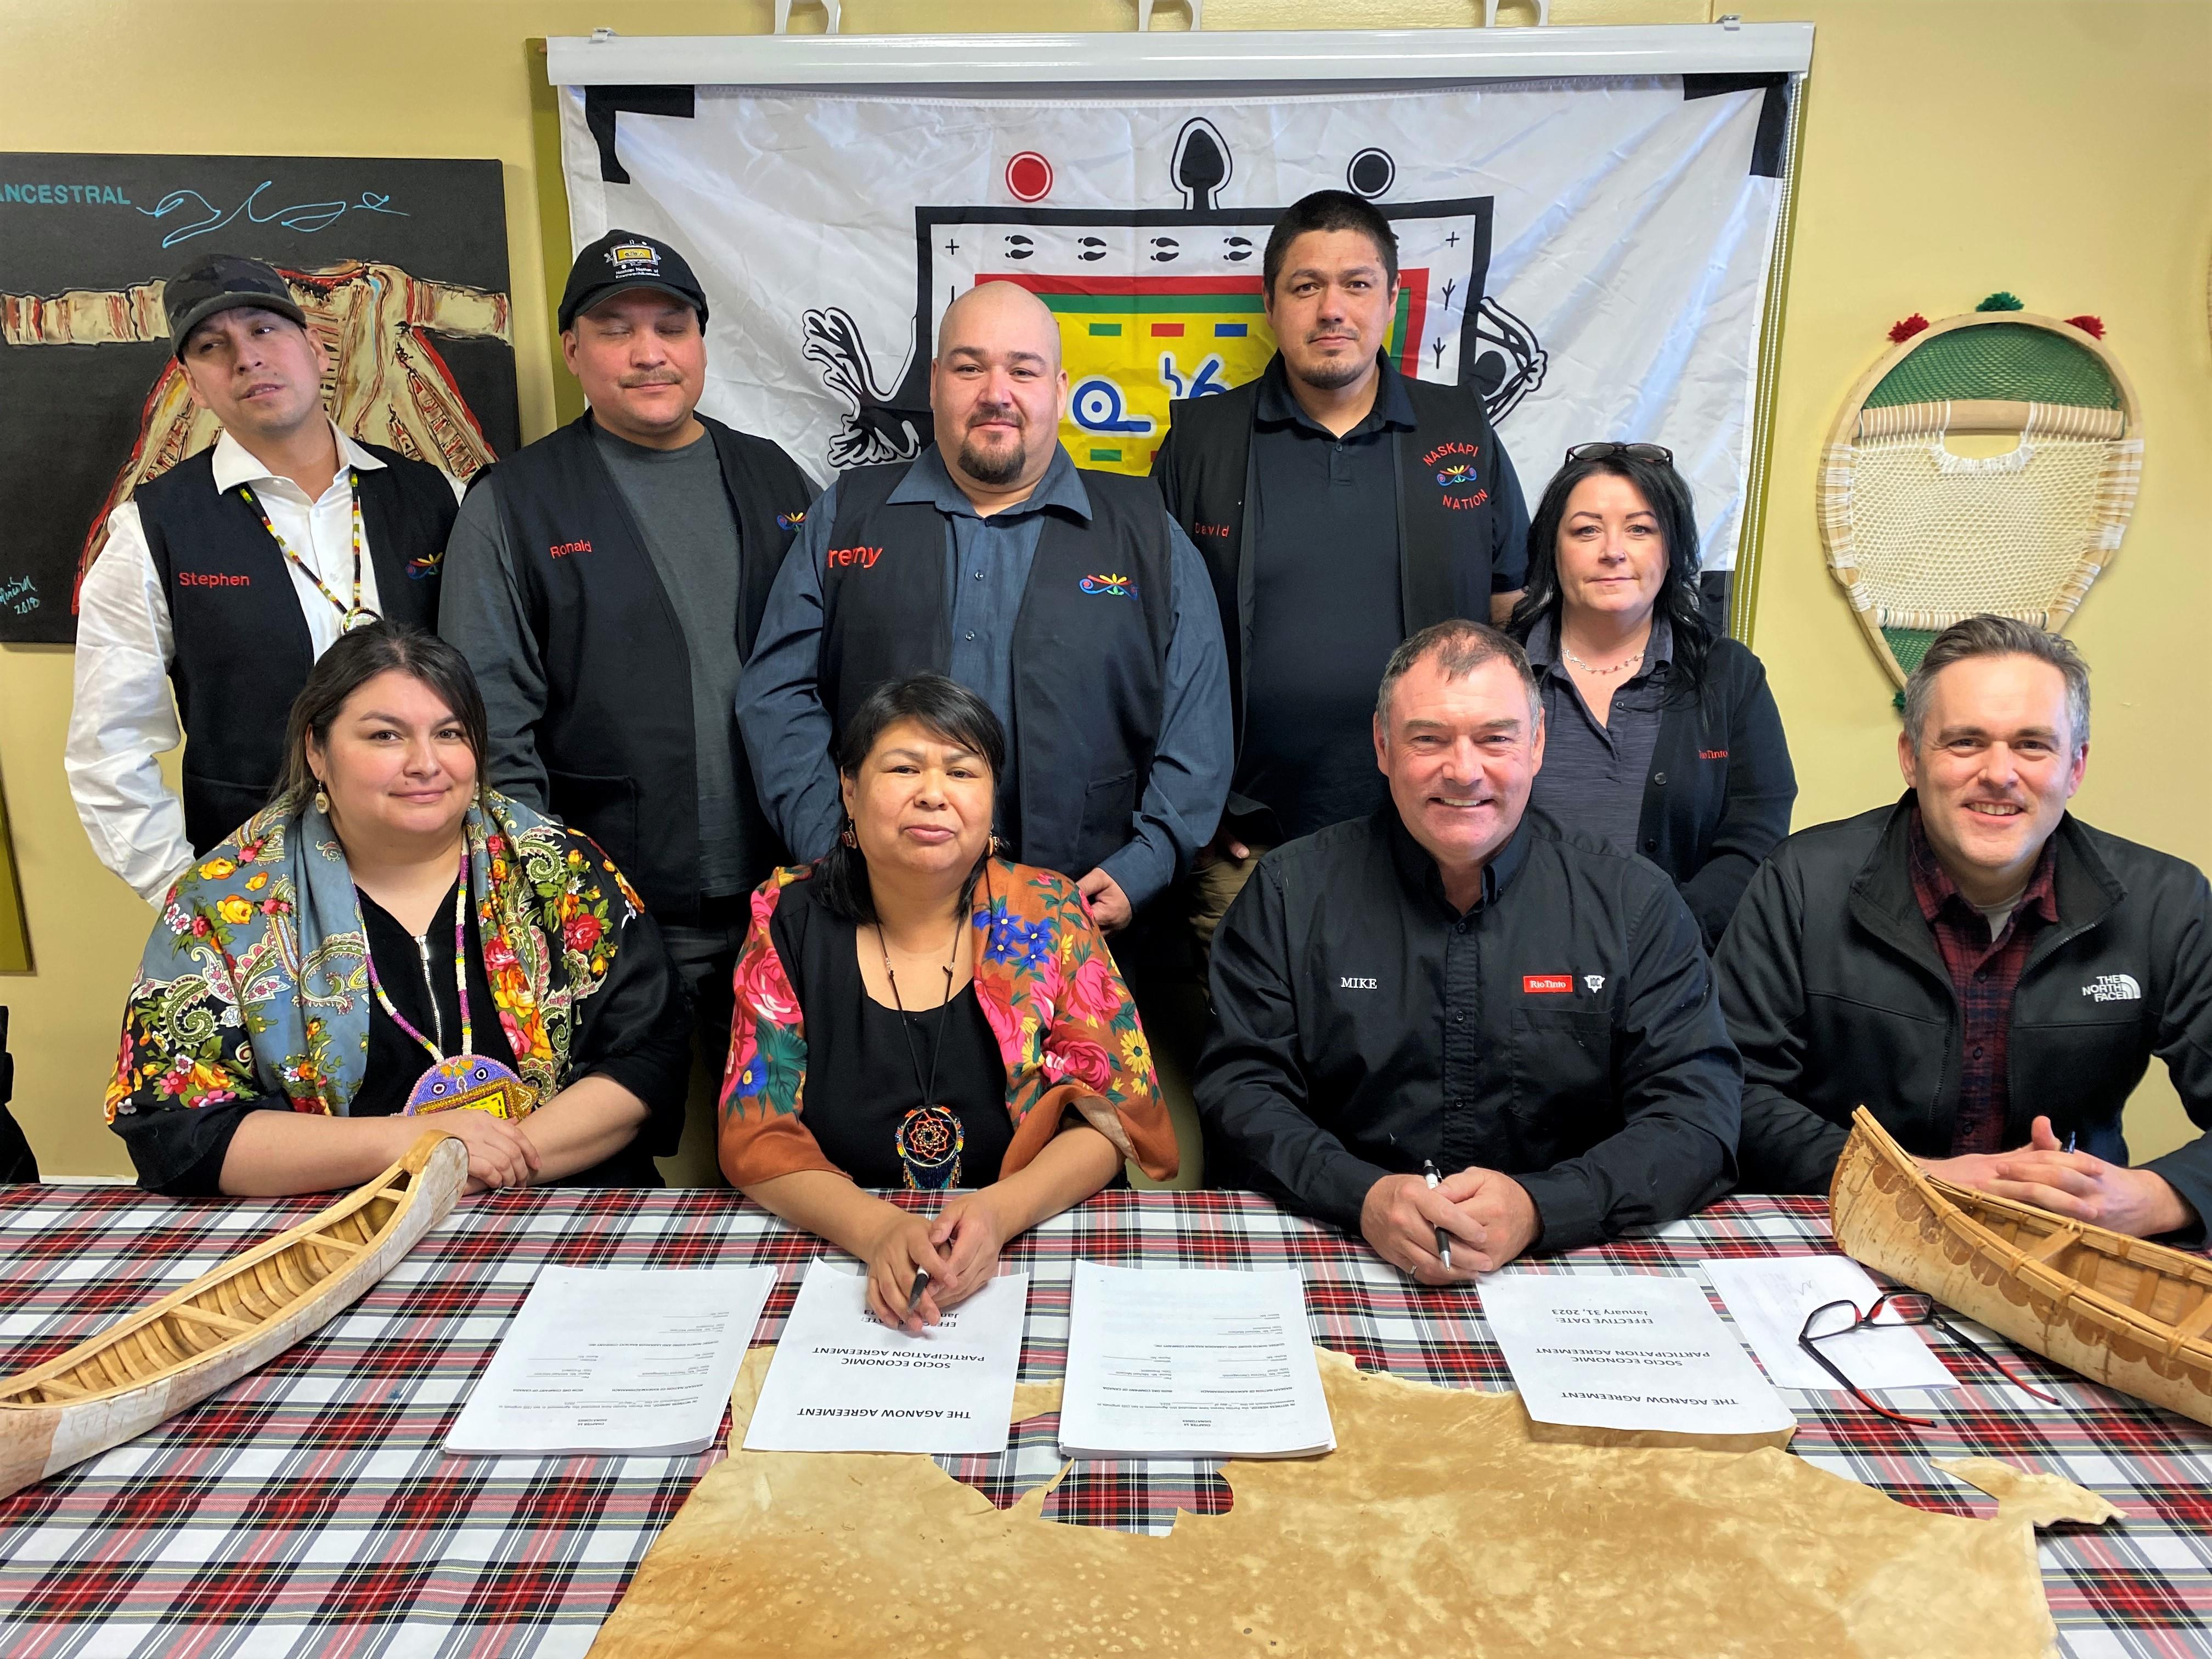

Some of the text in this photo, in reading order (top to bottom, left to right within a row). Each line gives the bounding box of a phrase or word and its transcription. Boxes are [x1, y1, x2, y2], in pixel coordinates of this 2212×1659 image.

[1423, 442, 1479, 466] NASKAPI
[1442, 488, 1488, 510] NATION
[1195, 522, 1229, 538] David
[550, 539, 592, 559] Ronald
[179, 572, 251, 589] Stephen
[1340, 977, 1378, 989] MIKE
[1590, 978, 1600, 987] IOC
[2096, 975, 2120, 985] THE
[2081, 983, 2121, 996] NORTH
[2094, 991, 2124, 1002] FACE
[812, 1347, 985, 1361] PARTICIPATION AGREEMENT
[840, 1358, 910, 1367] ECONOMIC
[1560, 1392, 1641, 1402] AGREEMENT
[1646, 1396, 1708, 1405] AGANOW
[797, 1408, 878, 1417] AGREEMENT
[881, 1409, 944, 1418] AGANOW
